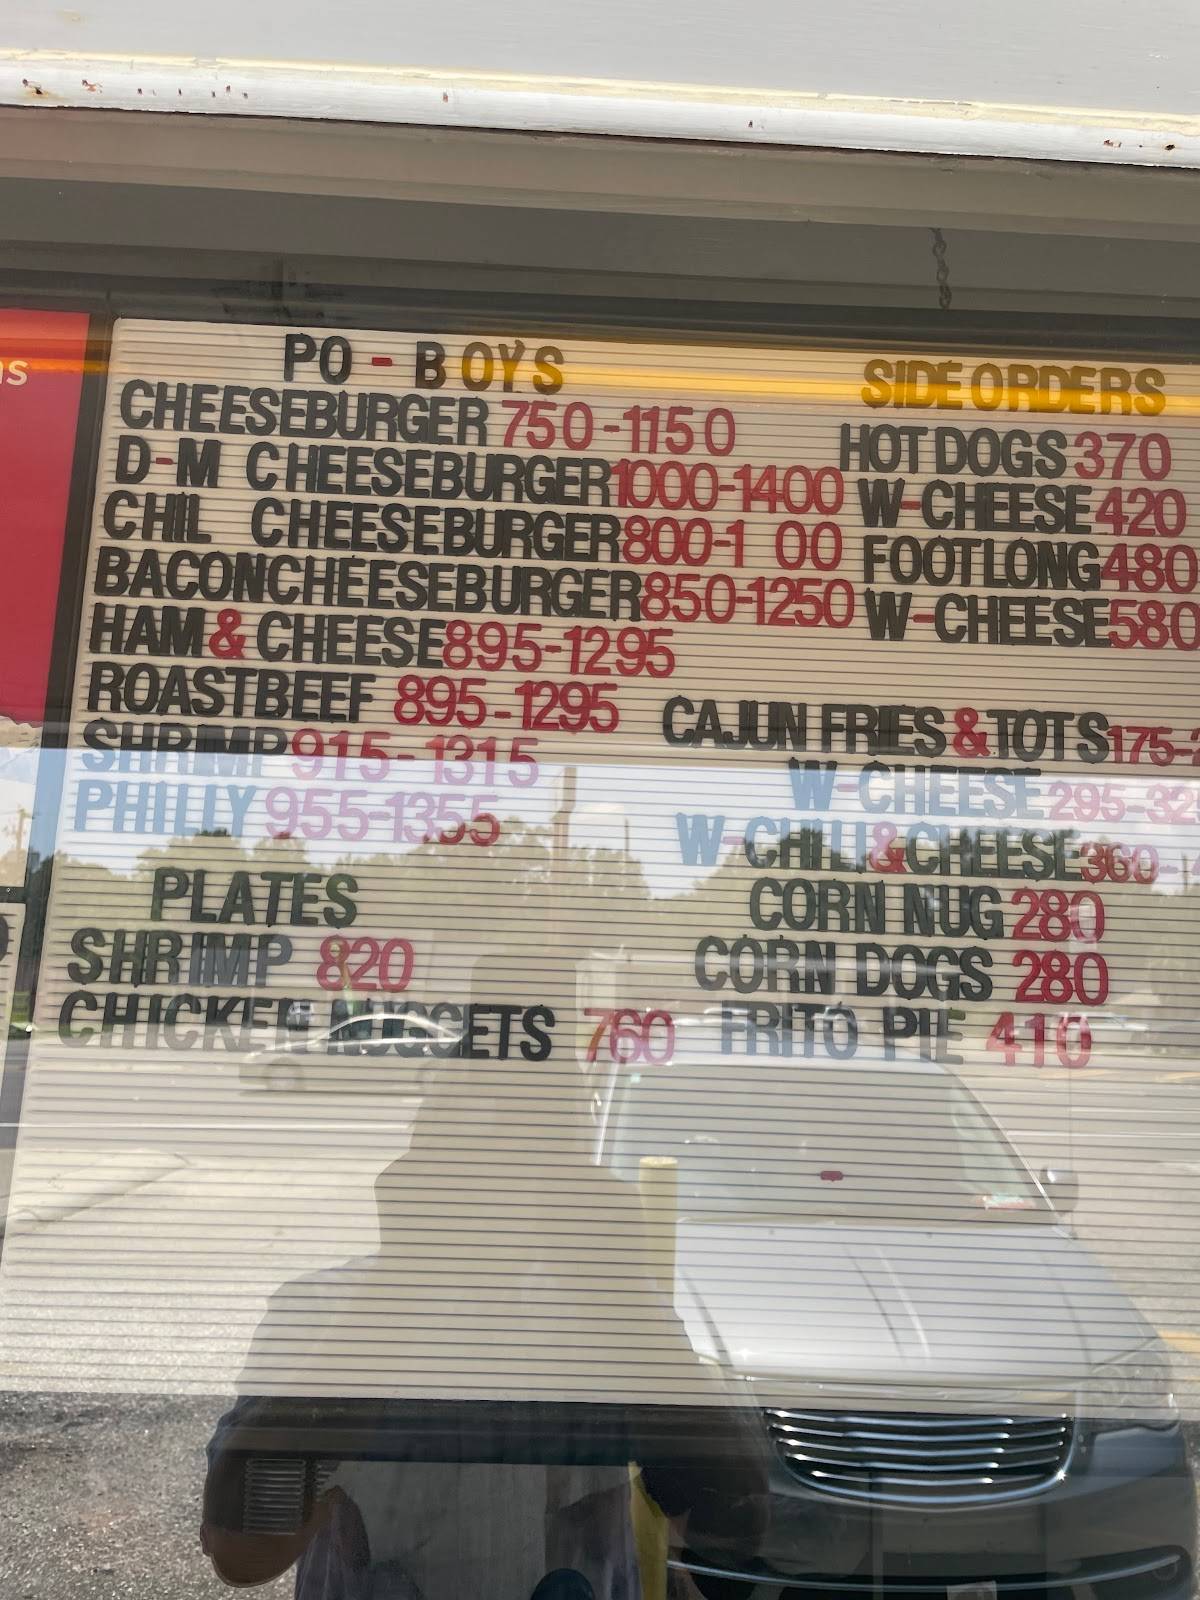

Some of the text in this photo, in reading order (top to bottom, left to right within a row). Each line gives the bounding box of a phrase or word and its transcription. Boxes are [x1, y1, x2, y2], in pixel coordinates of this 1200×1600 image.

[120, 379, 735, 456] CHEESEBURGER 750-1150
[971, 364, 1166, 416] ORDERS
[115, 434, 844, 515] D-M CHEESEBURGER 1000-1400
[936, 427, 1067, 478] DOGS
[1074, 431, 1172, 481] 370
[103, 489, 212, 544] CHIL
[251, 497, 621, 561] CHEESEBURGER
[858, 478, 1187, 538] W-CHEESE 420
[863, 535, 1198, 594] FOOTLONG 480
[640, 571, 854, 628] 850-1250
[864, 589, 1200, 651] W-CHEESE 580
[256, 611, 445, 668] CHEESE
[442, 620, 675, 678] 895-1295
[88, 662, 620, 733] ROASTBEEF 895-1295
[663, 695, 807, 751] CAJUN
[821, 703, 947, 757] FRIES
[987, 709, 1110, 764] TOTS
[82, 718, 539, 787] SHRIMP 915-1315
[74, 779, 500, 847] PHILLY 955-1355
[788, 757, 1044, 820] W-CHEESE
[905, 821, 1083, 882] CHEESE
[151, 867, 359, 928] PLATES
[749, 876, 1105, 943] CORN NUG 280
[67, 927, 293, 986] SHRIMP
[316, 935, 415, 992] 820
[694, 936, 1109, 1006] CORN DOGS 280
[58, 990, 675, 1065] CHICKEN NUGGETS 760
[720, 1001, 1092, 1068] FRITO PIE 410
